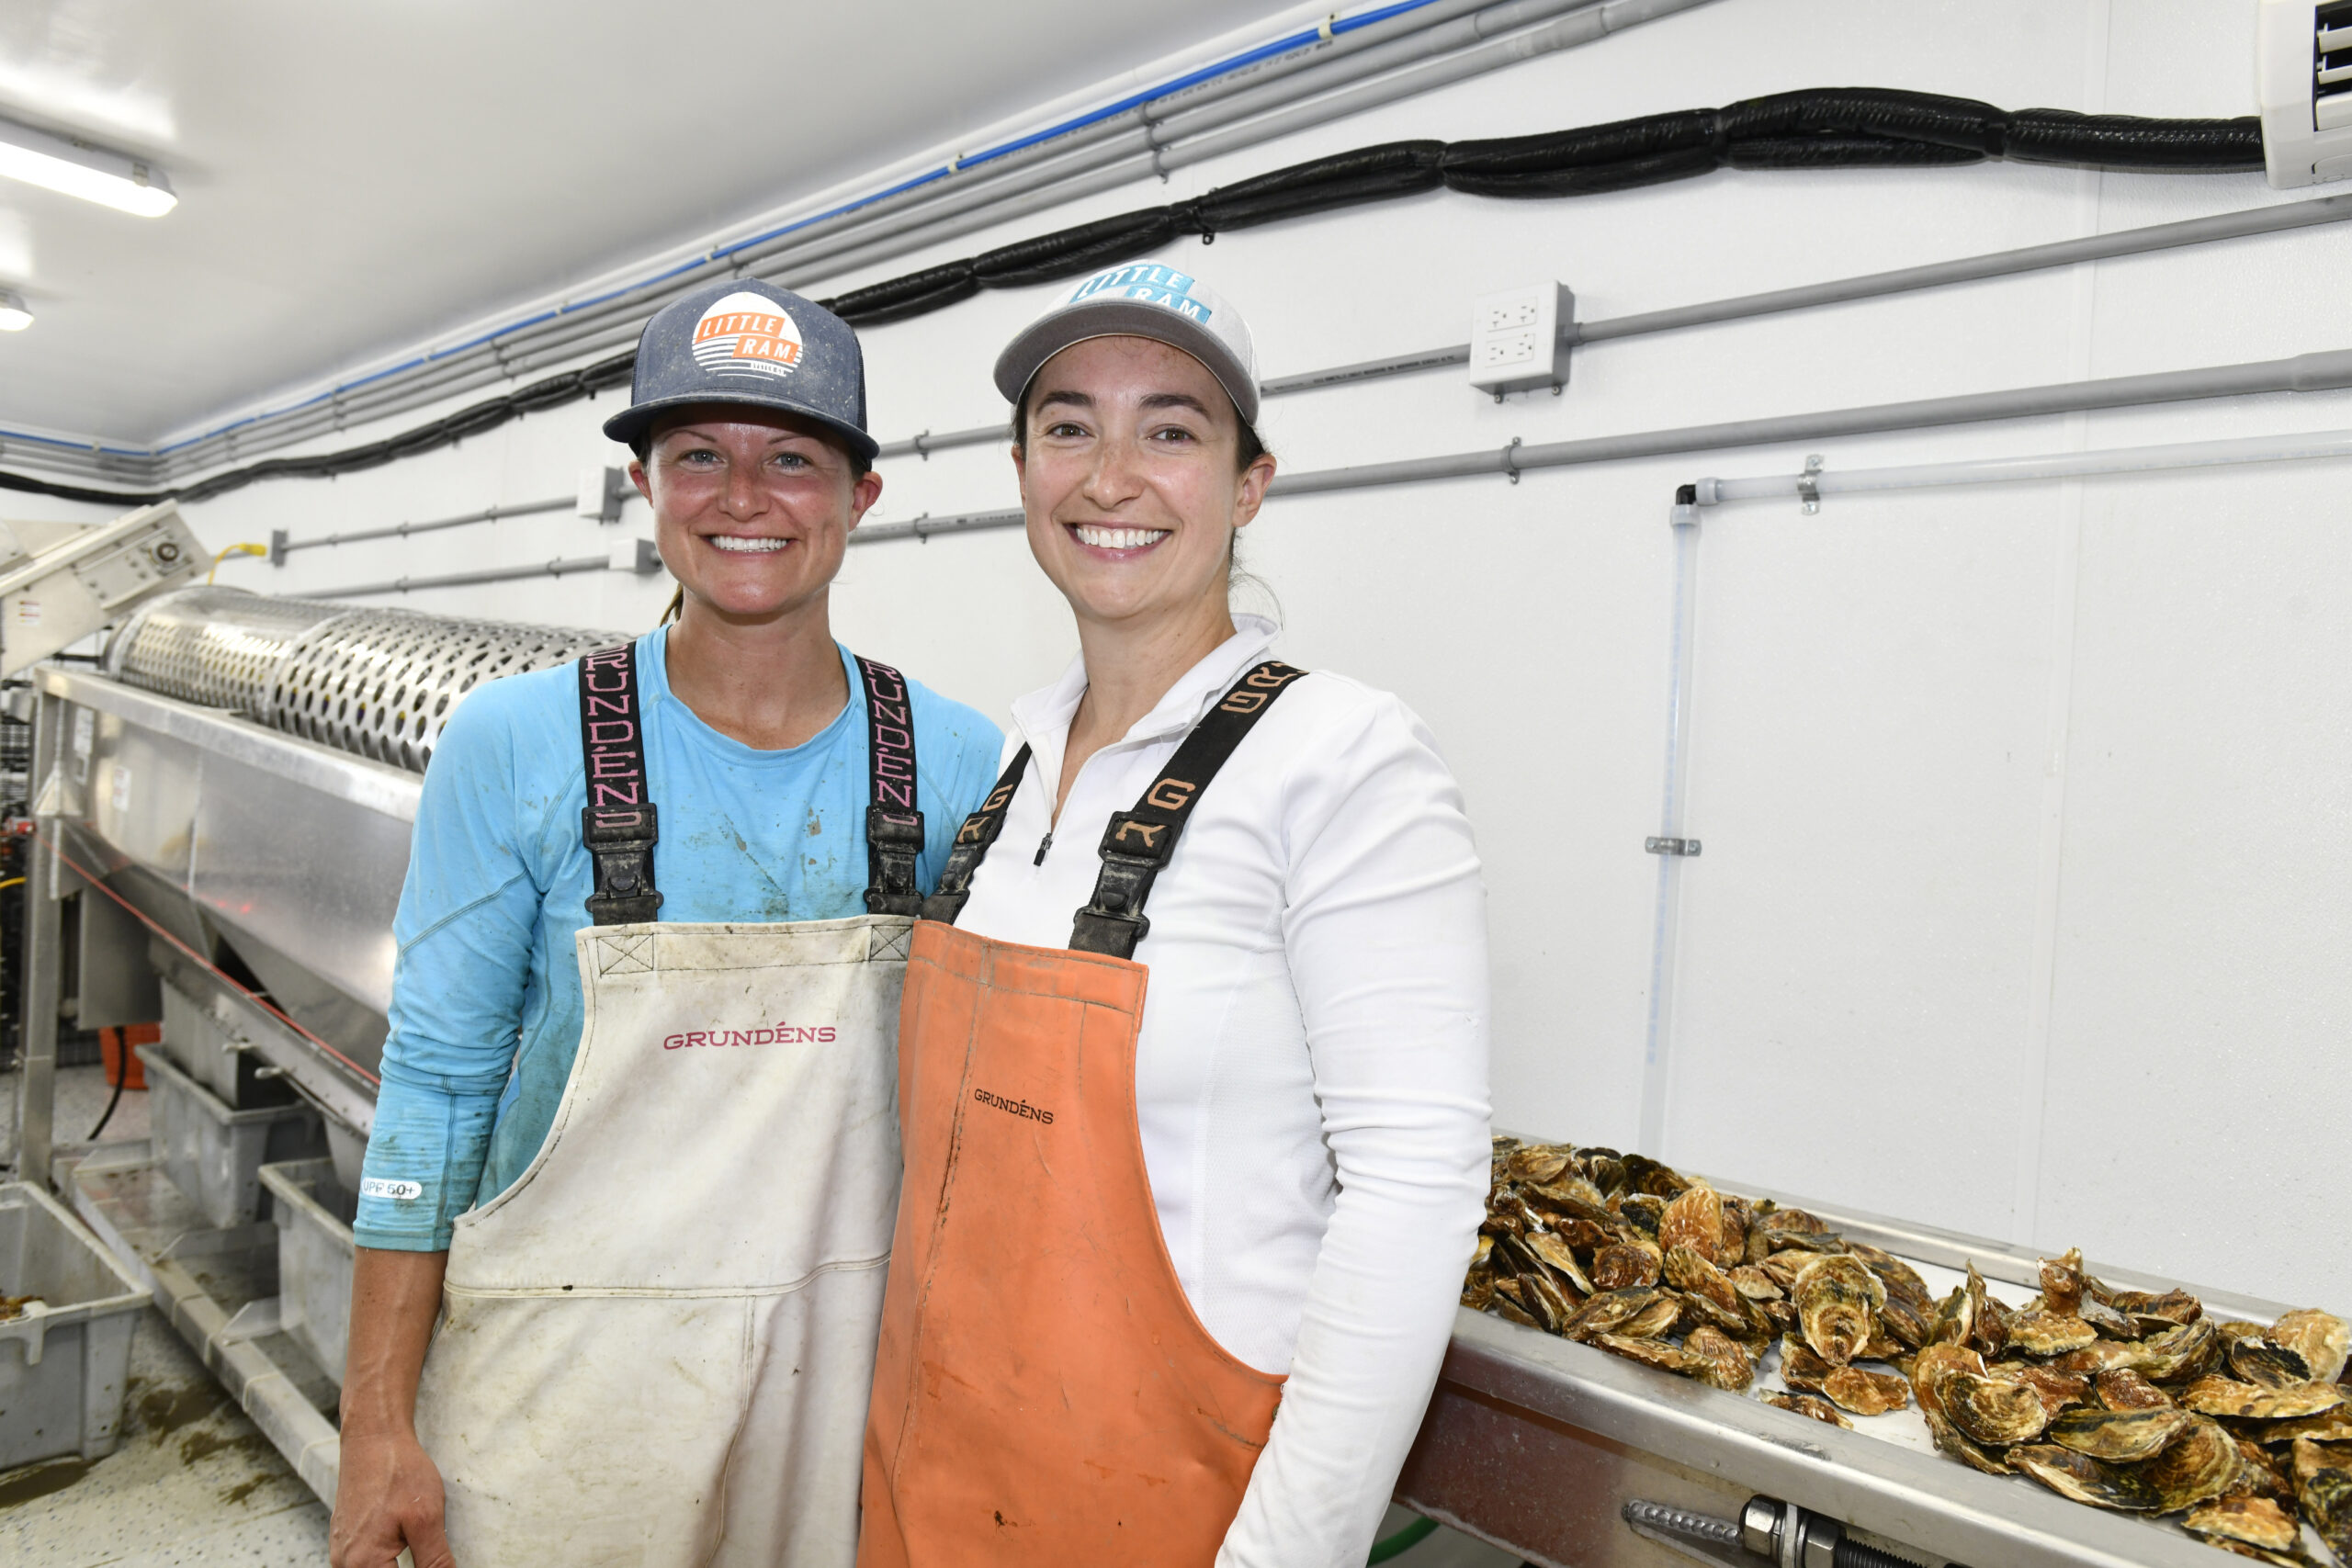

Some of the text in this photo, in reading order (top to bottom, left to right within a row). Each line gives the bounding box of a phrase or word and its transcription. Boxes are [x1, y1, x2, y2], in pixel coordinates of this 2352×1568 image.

[1077, 266, 1184, 299] LITTLE
[1134, 288, 1201, 318] RAM
[703, 315, 777, 338] LITTLE
[742, 338, 791, 360] RAM
[663, 1021, 836, 1050] GRUNDÉNS
[974, 1088, 1054, 1125] GRUNDÉNS
[362, 1181, 415, 1196] UPF 50+
